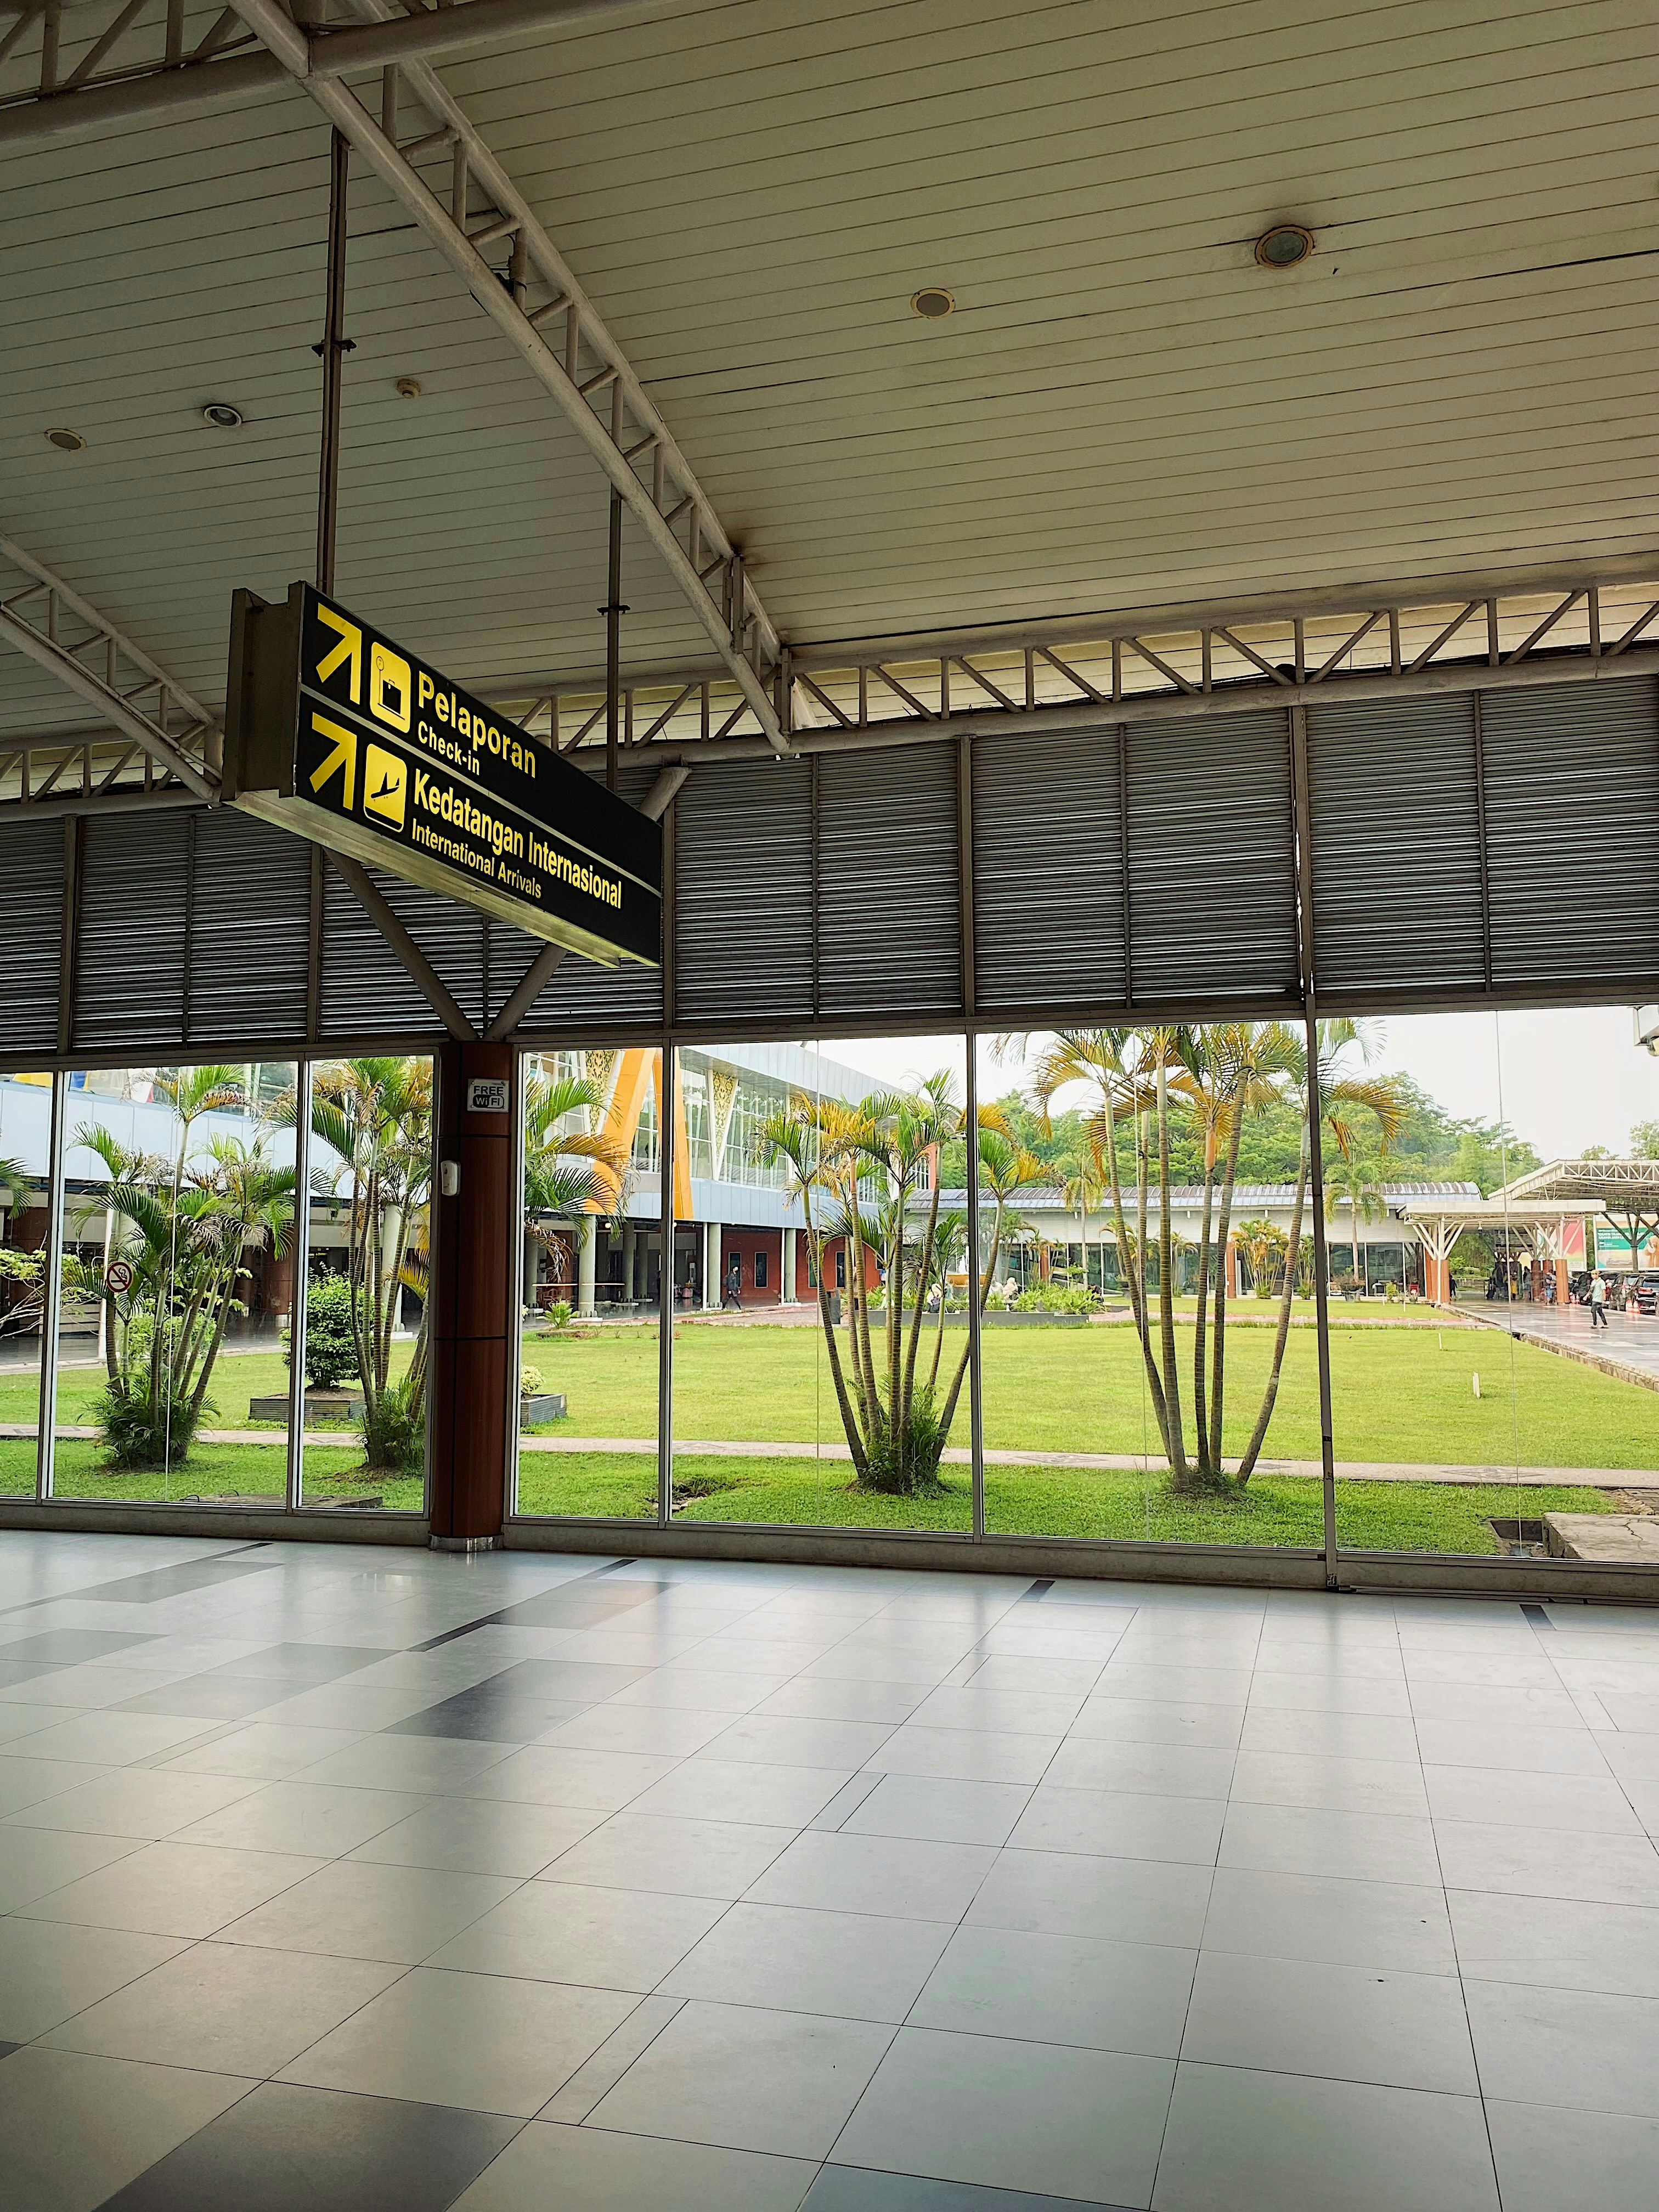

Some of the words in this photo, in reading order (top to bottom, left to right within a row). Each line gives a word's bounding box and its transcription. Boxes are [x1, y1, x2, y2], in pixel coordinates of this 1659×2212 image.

[418, 721, 480, 776] Check-in
[419, 670, 535, 778] Pelaporan
[412, 818, 495, 877] International
[498, 861, 541, 899] Arrivals
[414, 768, 523, 858] Kedatangan
[528, 831, 622, 909] Internasional
[473, 1085, 504, 1095] FREE
